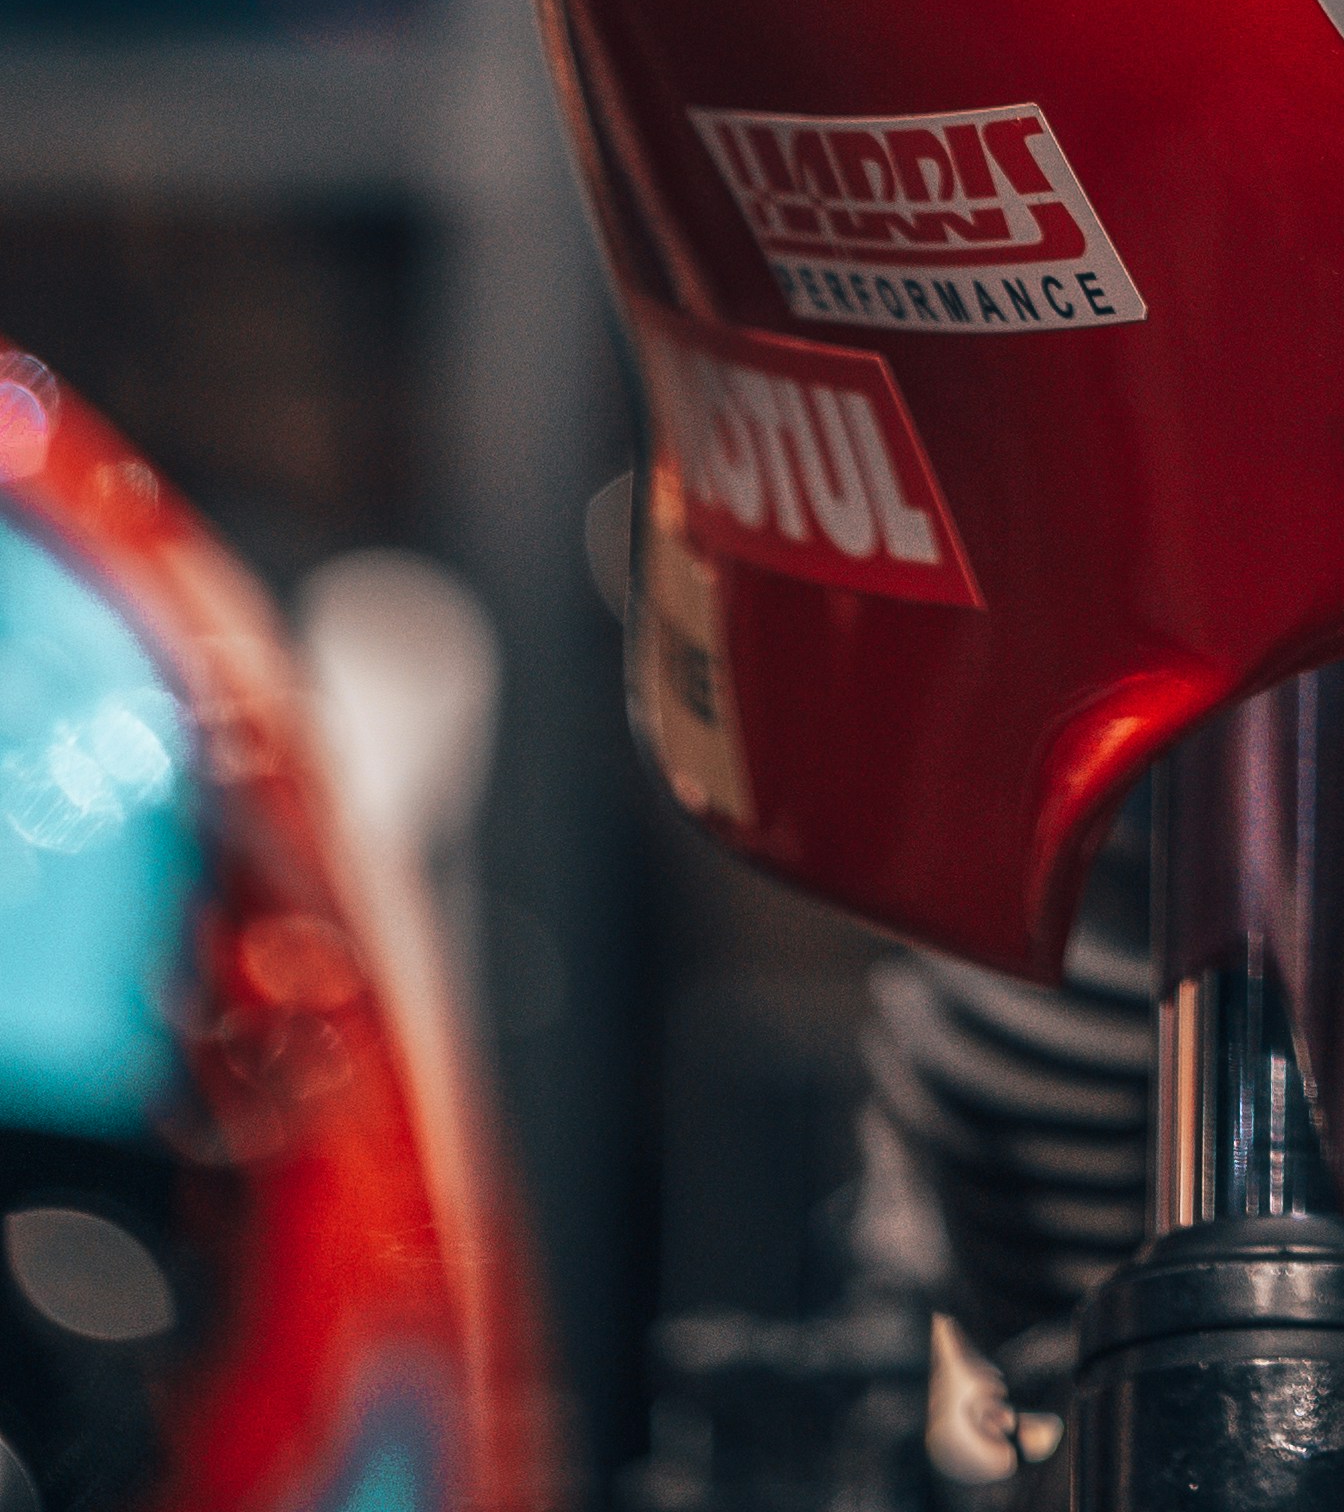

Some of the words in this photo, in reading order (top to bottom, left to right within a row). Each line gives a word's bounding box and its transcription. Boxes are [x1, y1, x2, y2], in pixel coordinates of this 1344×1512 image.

[718, 116, 1087, 267] HARRIS
[779, 271, 1116, 323] PERFORMANCE
[688, 364, 940, 565] OTUL
